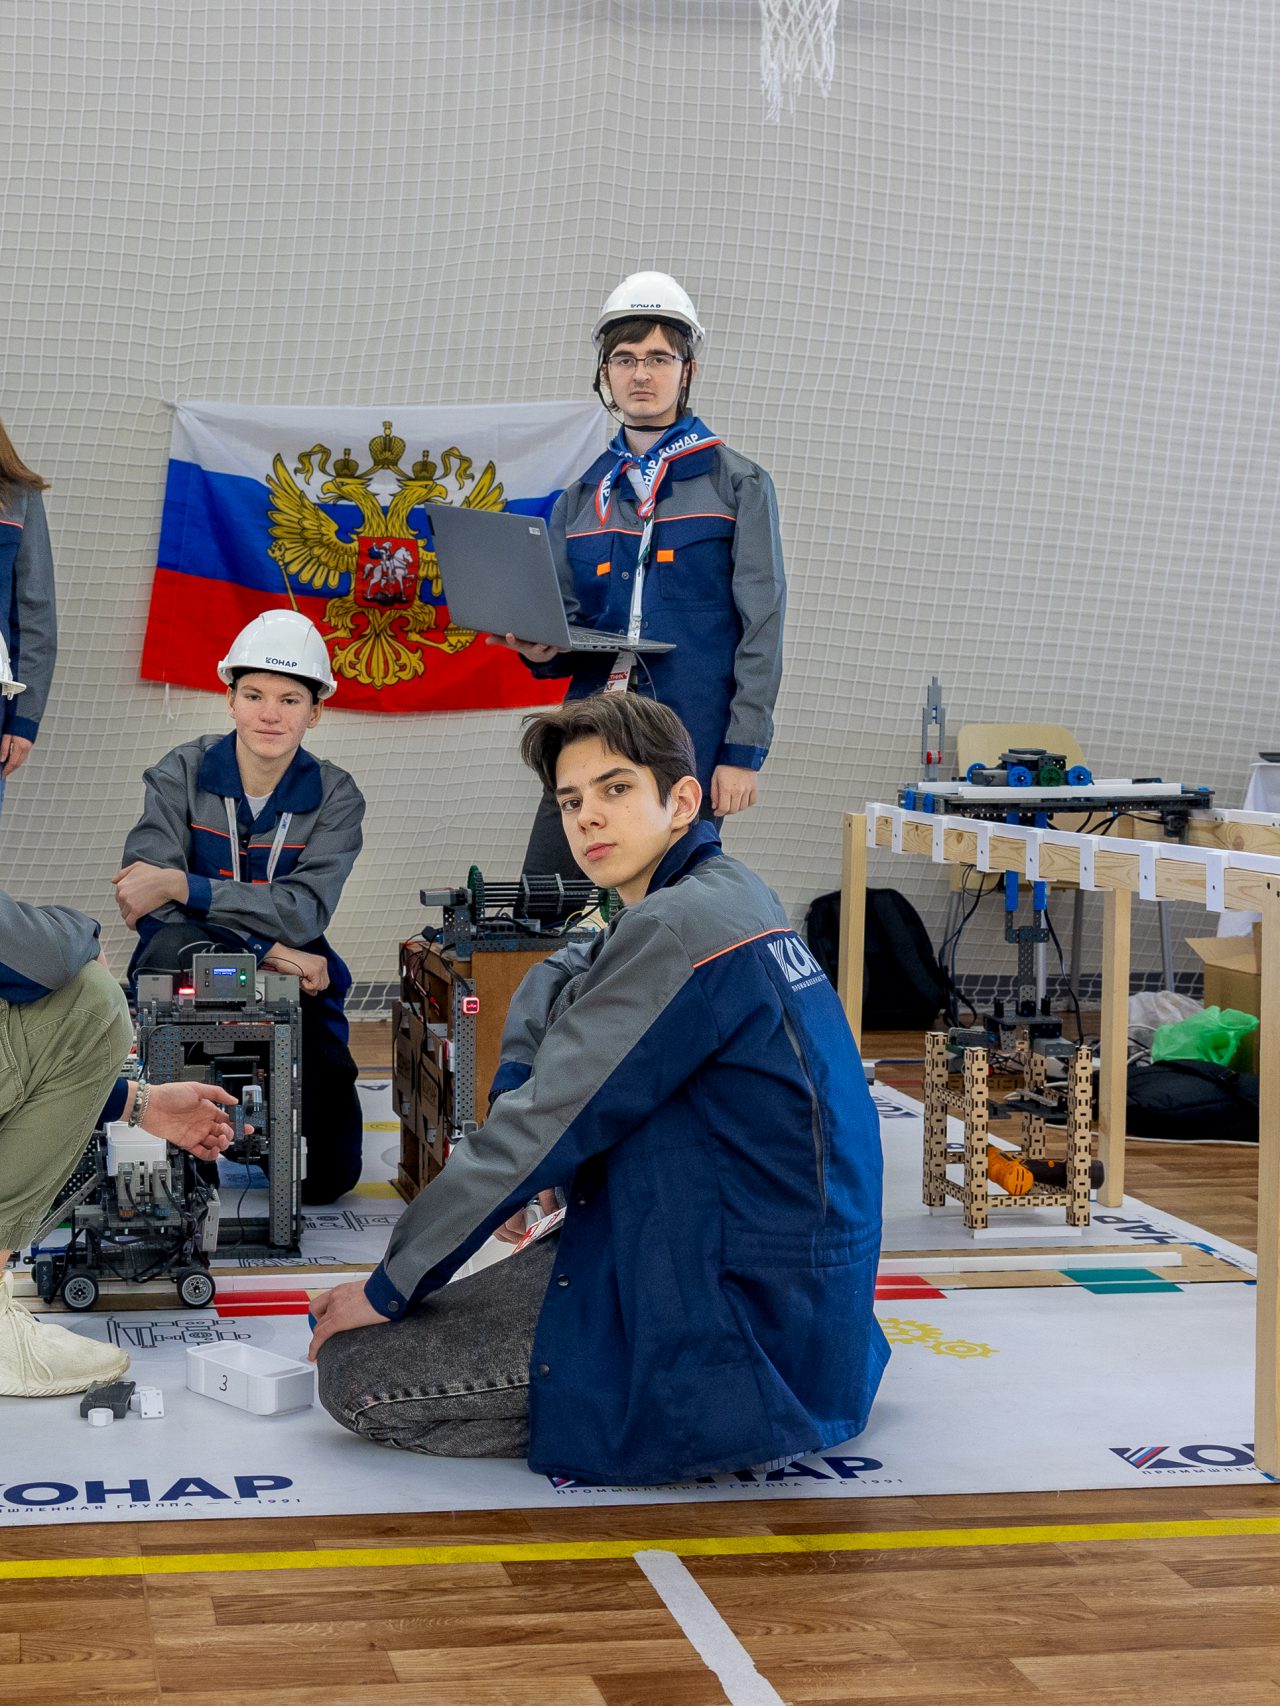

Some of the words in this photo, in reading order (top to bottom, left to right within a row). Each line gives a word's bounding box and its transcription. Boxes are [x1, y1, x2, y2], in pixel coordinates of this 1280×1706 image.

[265, 656, 298, 668] КОНАР
[218, 1374, 228, 1392] 3
[555, 1483, 718, 1496] ПРОМЫШЛЕННАЯ
[728, 1481, 804, 1490] ГРУППА
[861, 1478, 906, 1486] 1991
[116, 1501, 194, 1510] ГРУППА
[257, 1497, 302, 1505] 1991
